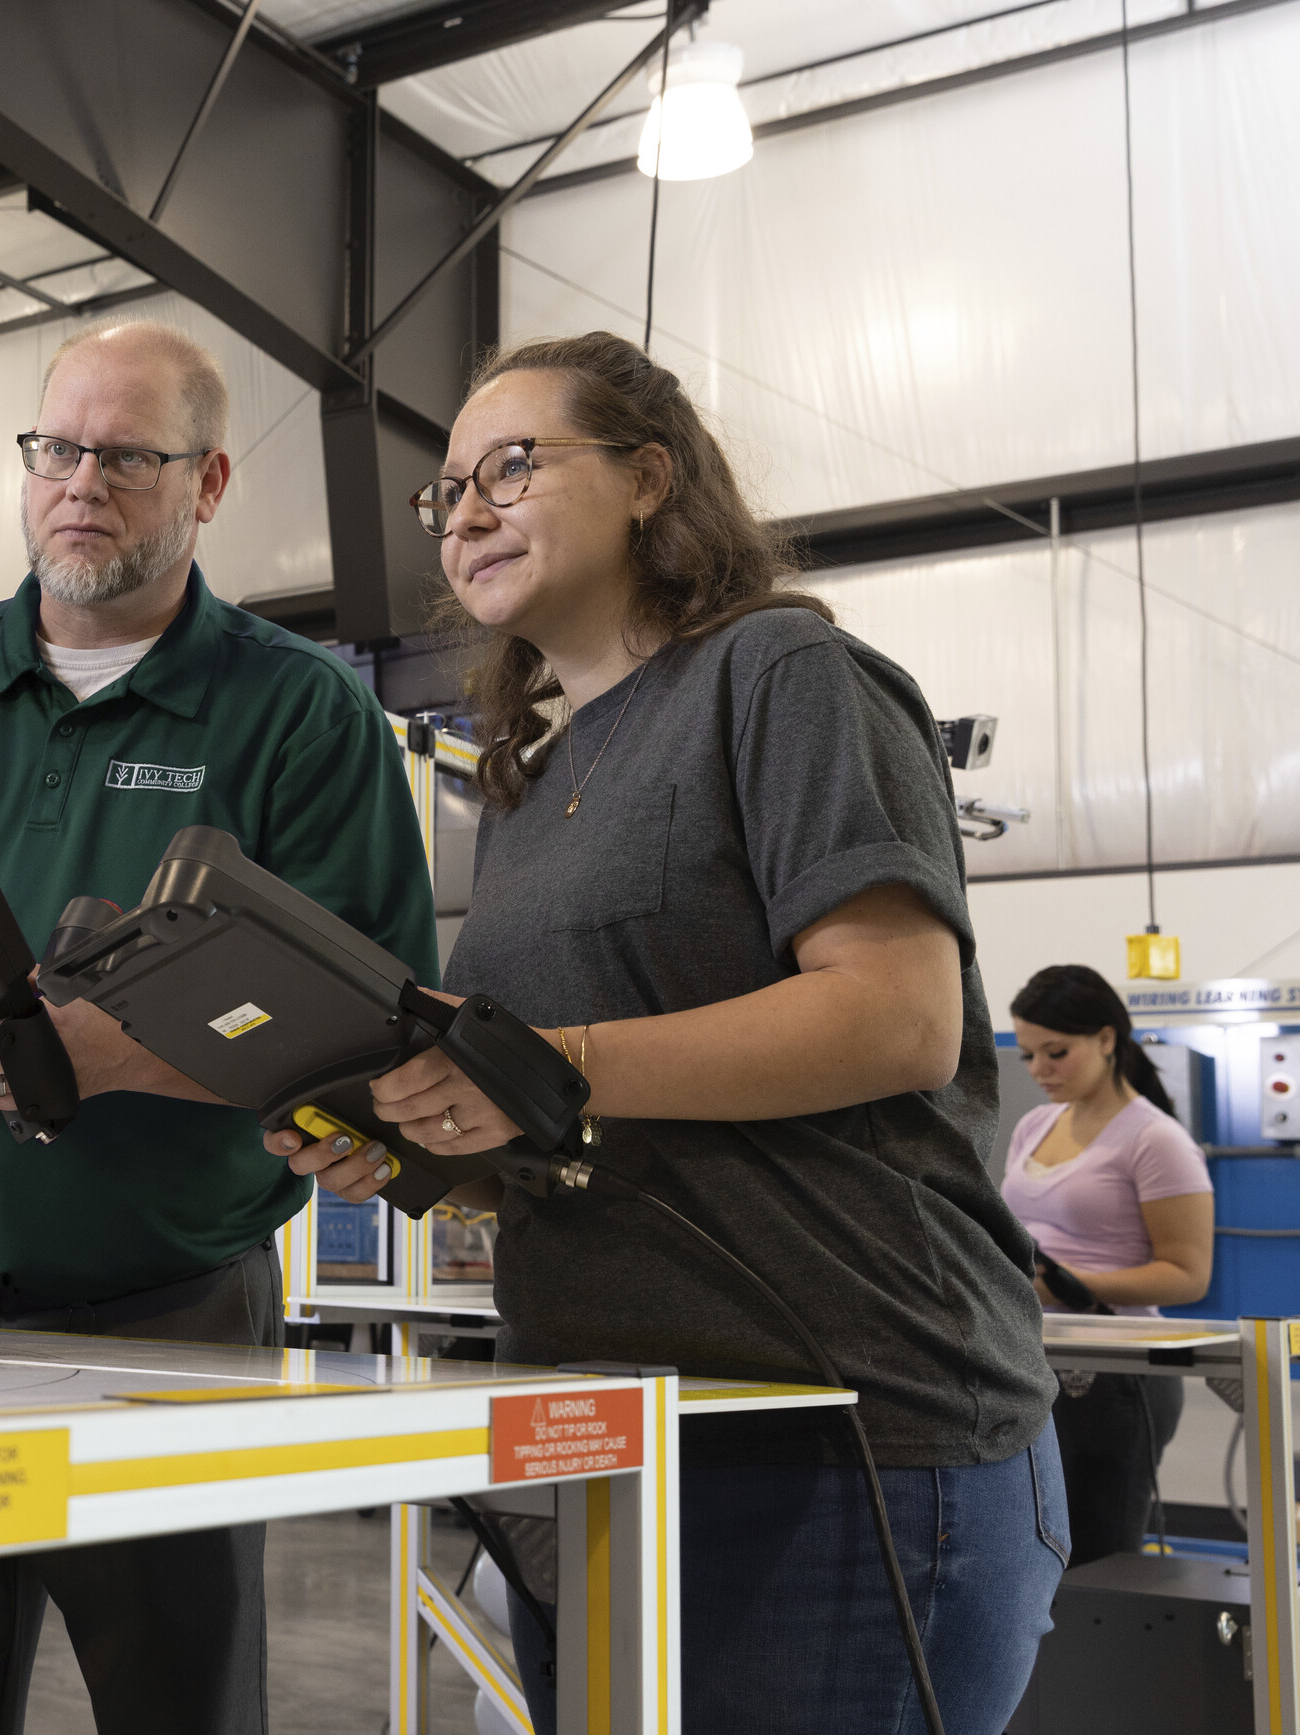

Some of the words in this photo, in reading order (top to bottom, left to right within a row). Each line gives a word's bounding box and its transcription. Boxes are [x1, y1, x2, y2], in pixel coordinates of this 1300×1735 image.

[137, 779, 172, 787] COMMUNITY
[138, 769, 163, 780] IVY
[166, 771, 201, 783] TECH
[1127, 990, 1191, 1007] WIRING
[1195, 987, 1282, 1005] LEARNING
[548, 1398, 596, 1419] WARNING
[535, 1426, 547, 1441] DO
[547, 1424, 563, 1439] NOT
[563, 1423, 575, 1437] TIP
[575, 1422, 586, 1436] OR
[587, 1421, 607, 1435] ROCK
[514, 1444, 543, 1459] TIPPING
[544, 1442, 555, 1457] OR
[556, 1439, 588, 1455] ROCKING
[589, 1438, 603, 1452] MAY
[603, 1435, 627, 1450] CAUSE
[525, 1459, 557, 1477] SERIOUS
[559, 1457, 582, 1472] INJURY
[583, 1455, 594, 1470] OR
[594, 1453, 617, 1468] DEATH
